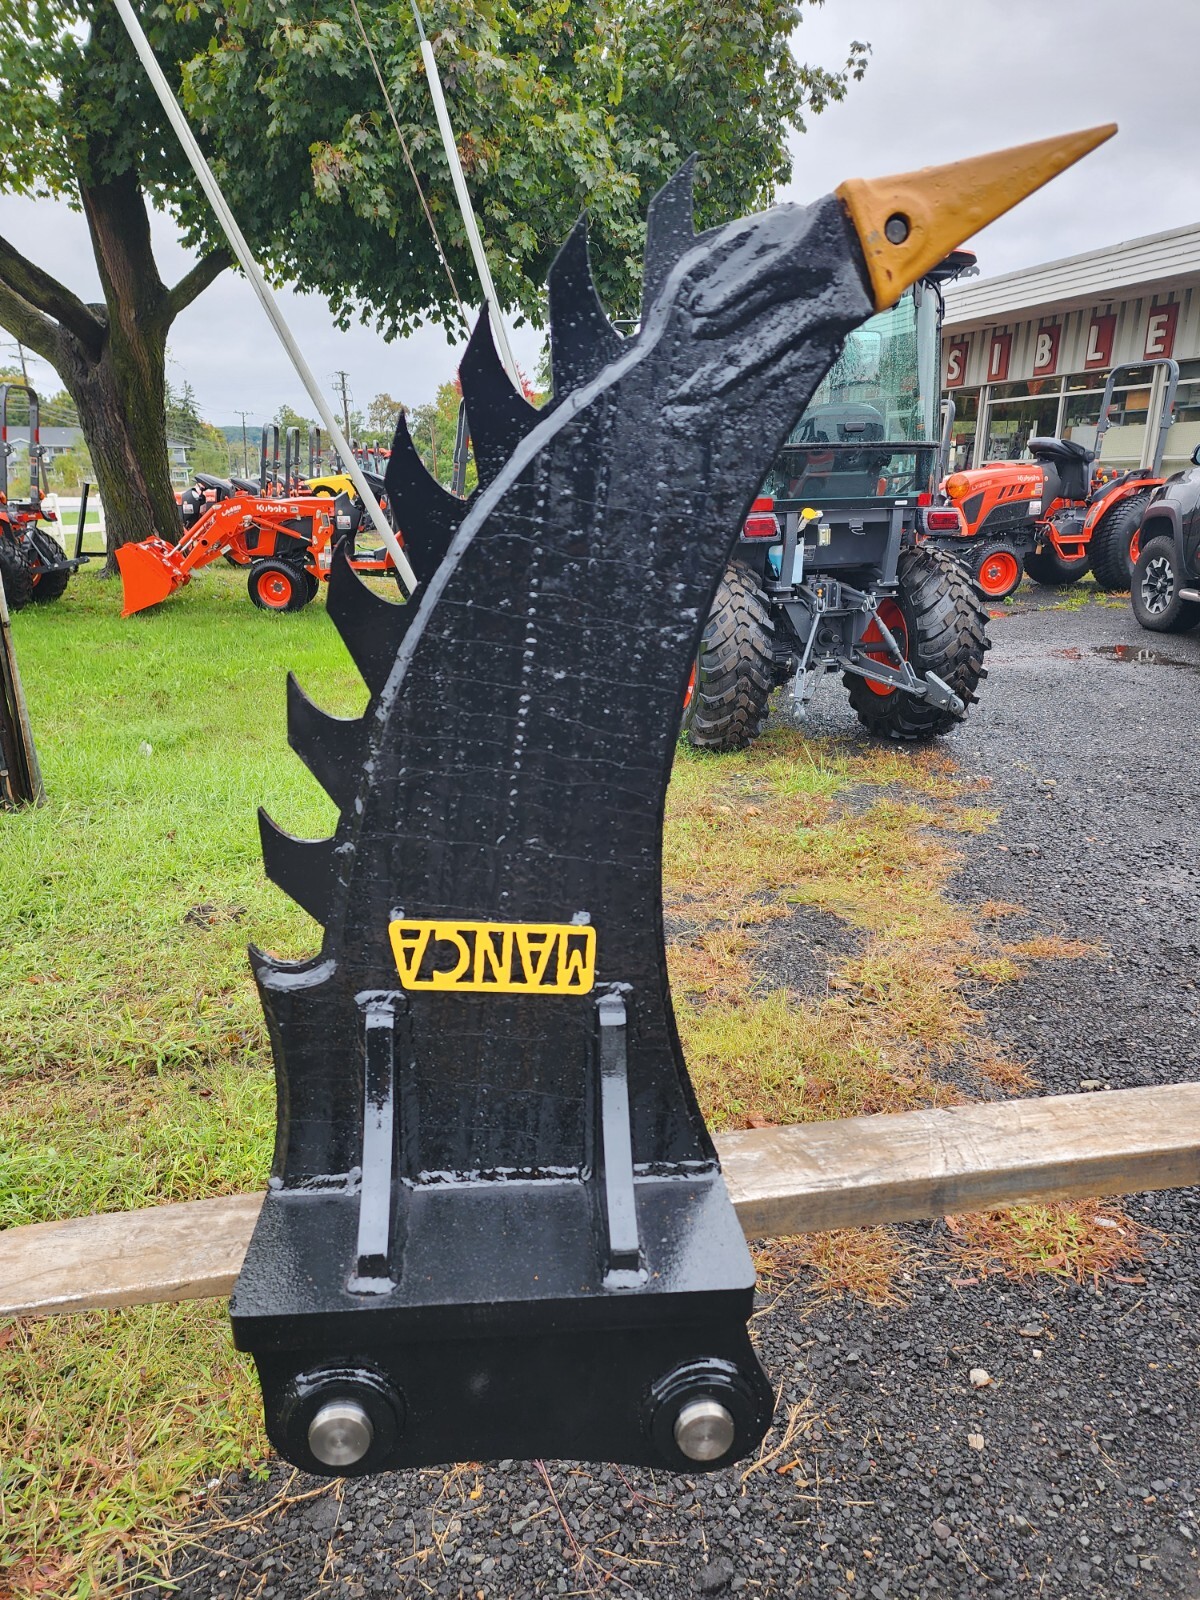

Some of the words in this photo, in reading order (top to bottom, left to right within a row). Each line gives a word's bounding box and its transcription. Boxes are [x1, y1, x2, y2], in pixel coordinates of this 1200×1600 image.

[1017, 474, 1040, 482] Kubota
[256, 503, 288, 513] Kubota
[391, 923, 595, 991] MANCA
